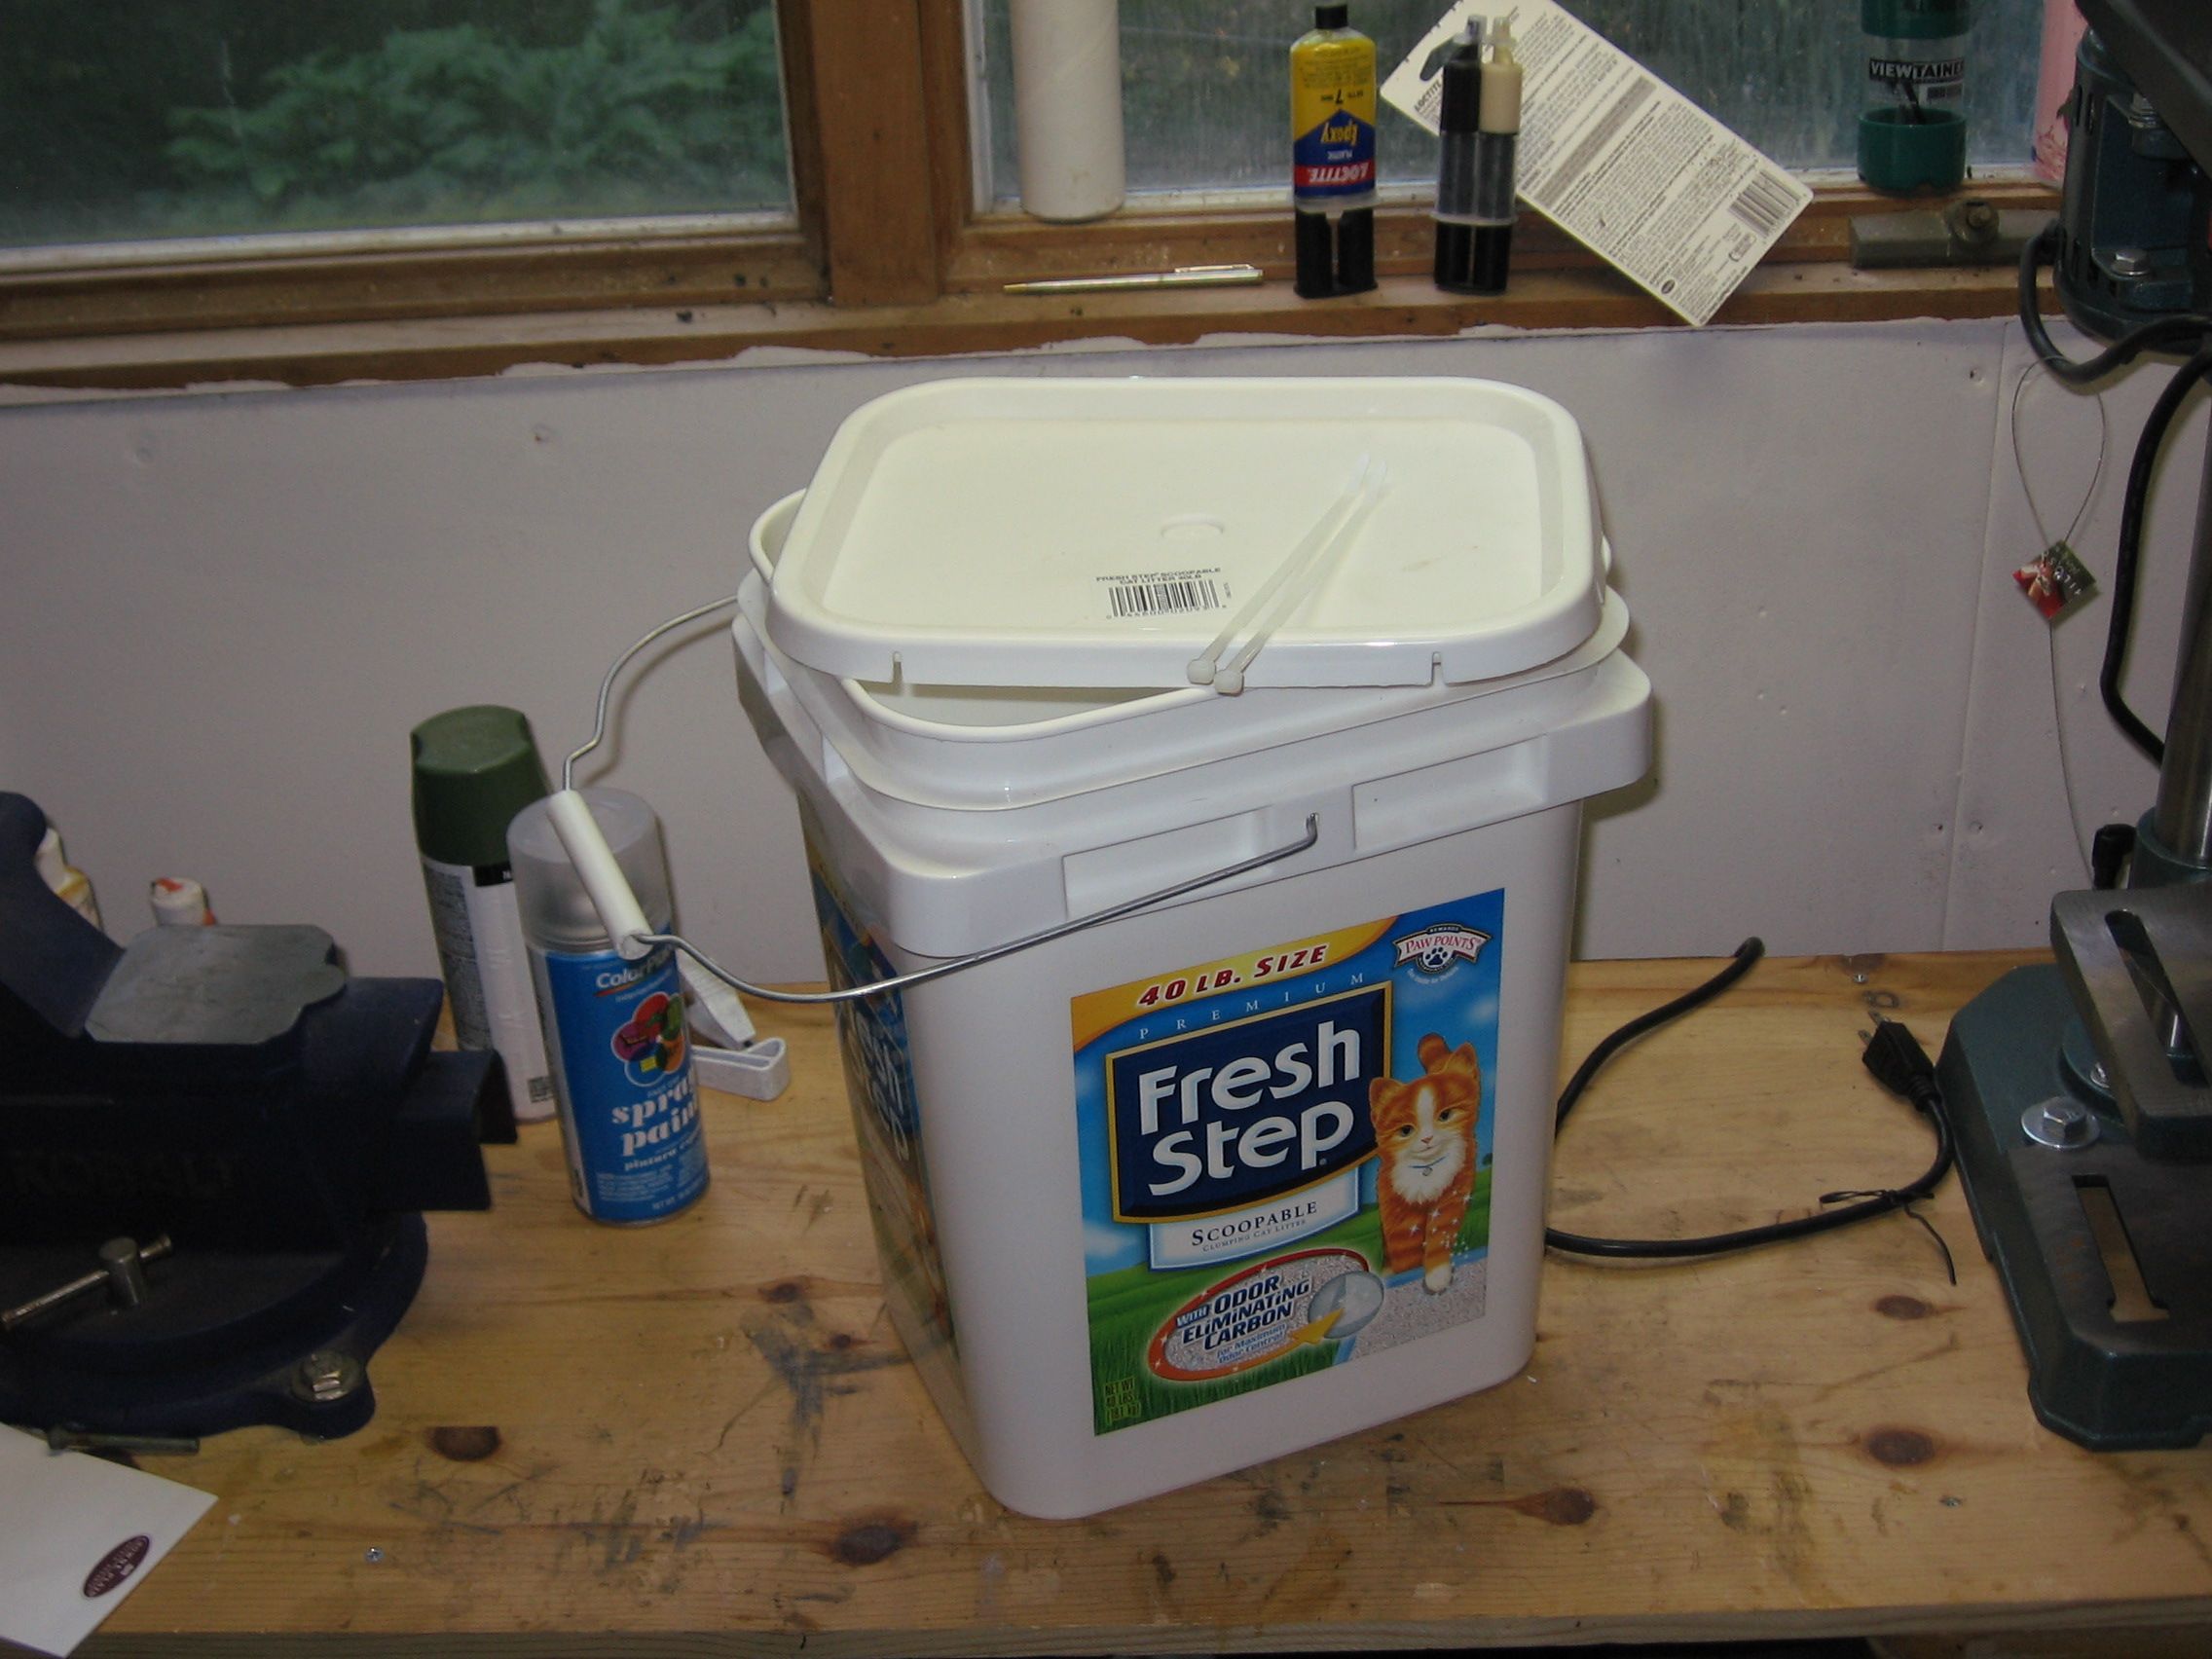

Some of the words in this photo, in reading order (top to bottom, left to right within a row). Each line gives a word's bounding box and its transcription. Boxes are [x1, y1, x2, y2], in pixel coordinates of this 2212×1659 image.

[1871, 60, 1964, 79] VIEWTAINE
[1320, 118, 1357, 146] Epoxy
[1308, 162, 1370, 183] LOCTITE
[1254, 944, 1327, 978] SIZE
[1405, 937, 1434, 953] PAW
[1434, 935, 1475, 950] POINTS
[1139, 973, 1363, 1040] PREMIUM
[1138, 1020, 1360, 1135] Fresh
[611, 1076, 689, 1127] spra
[622, 1101, 694, 1157] pain
[1149, 1099, 1354, 1196] Step
[1192, 1201, 1317, 1246] SCOOPABLE
[1202, 1235, 1251, 1252] CLUMPING
[1253, 1228, 1272, 1238] CAT
[1214, 1274, 1280, 1314] ODOR
[1204, 1302, 1294, 1350] CARBON
